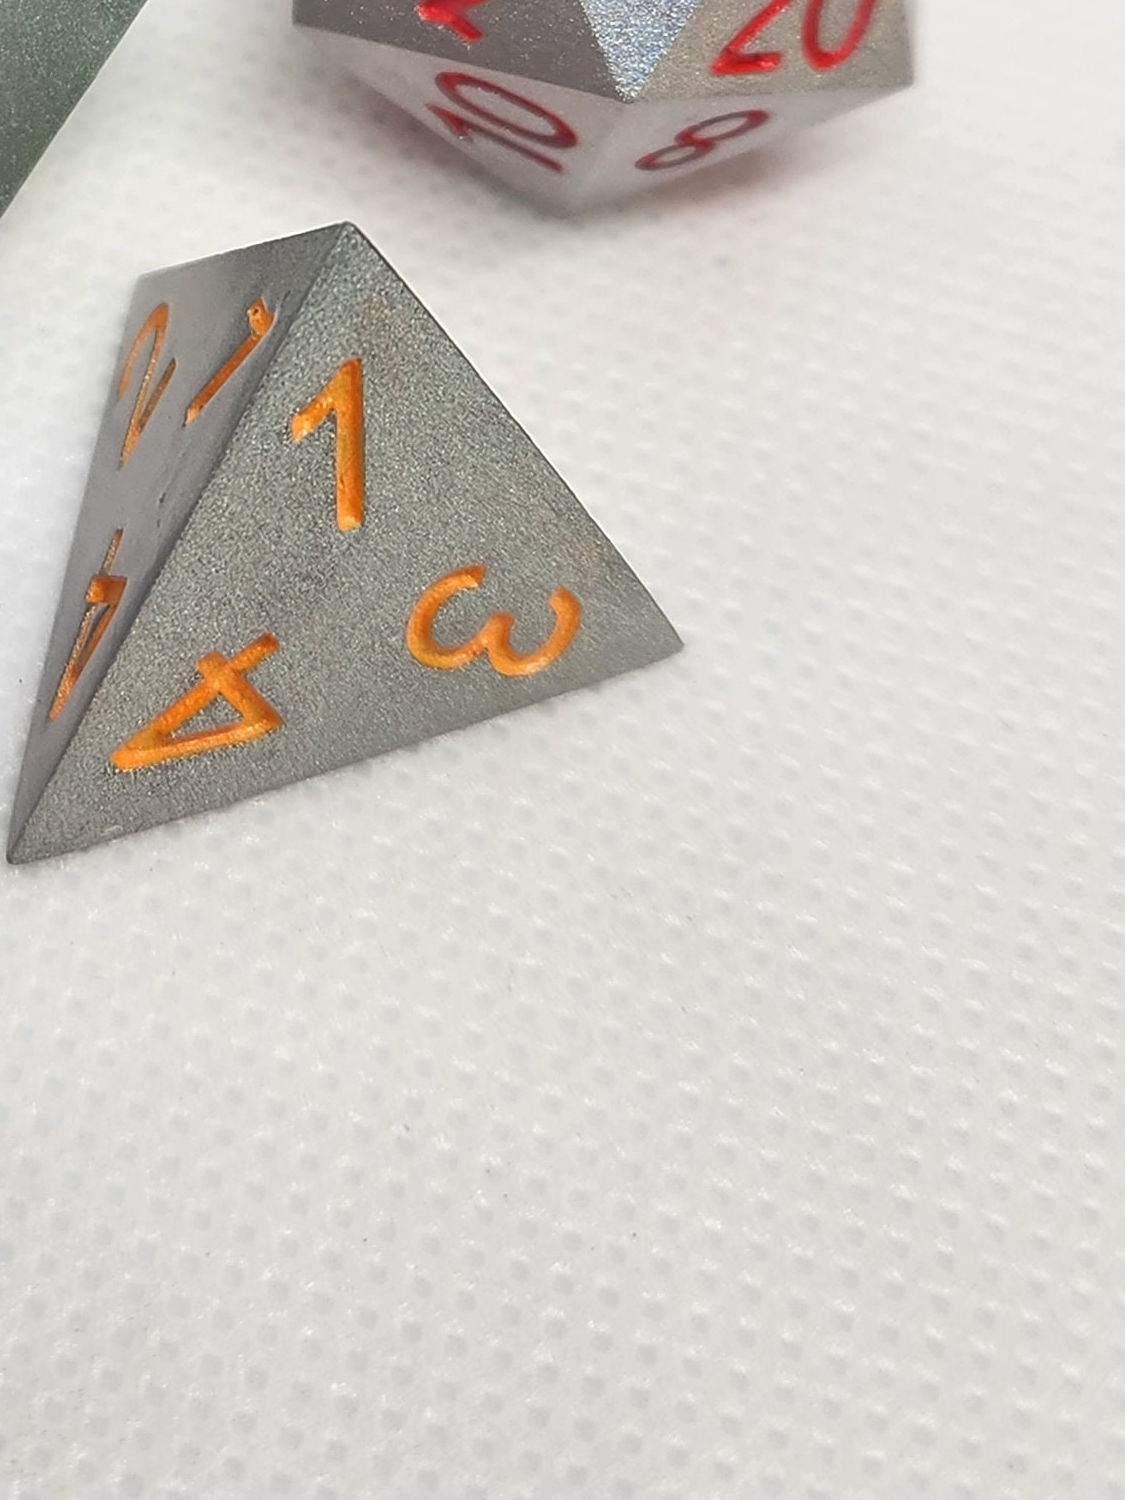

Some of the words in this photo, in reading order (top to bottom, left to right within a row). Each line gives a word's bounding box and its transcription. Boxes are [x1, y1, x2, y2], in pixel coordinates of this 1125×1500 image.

[425, 71, 579, 173] 10
[635, 109, 769, 171] 8
[183, 297, 275, 427] 1
[290, 357, 366, 533] 1
[405, 564, 583, 679] 3
[109, 632, 284, 774] 4
